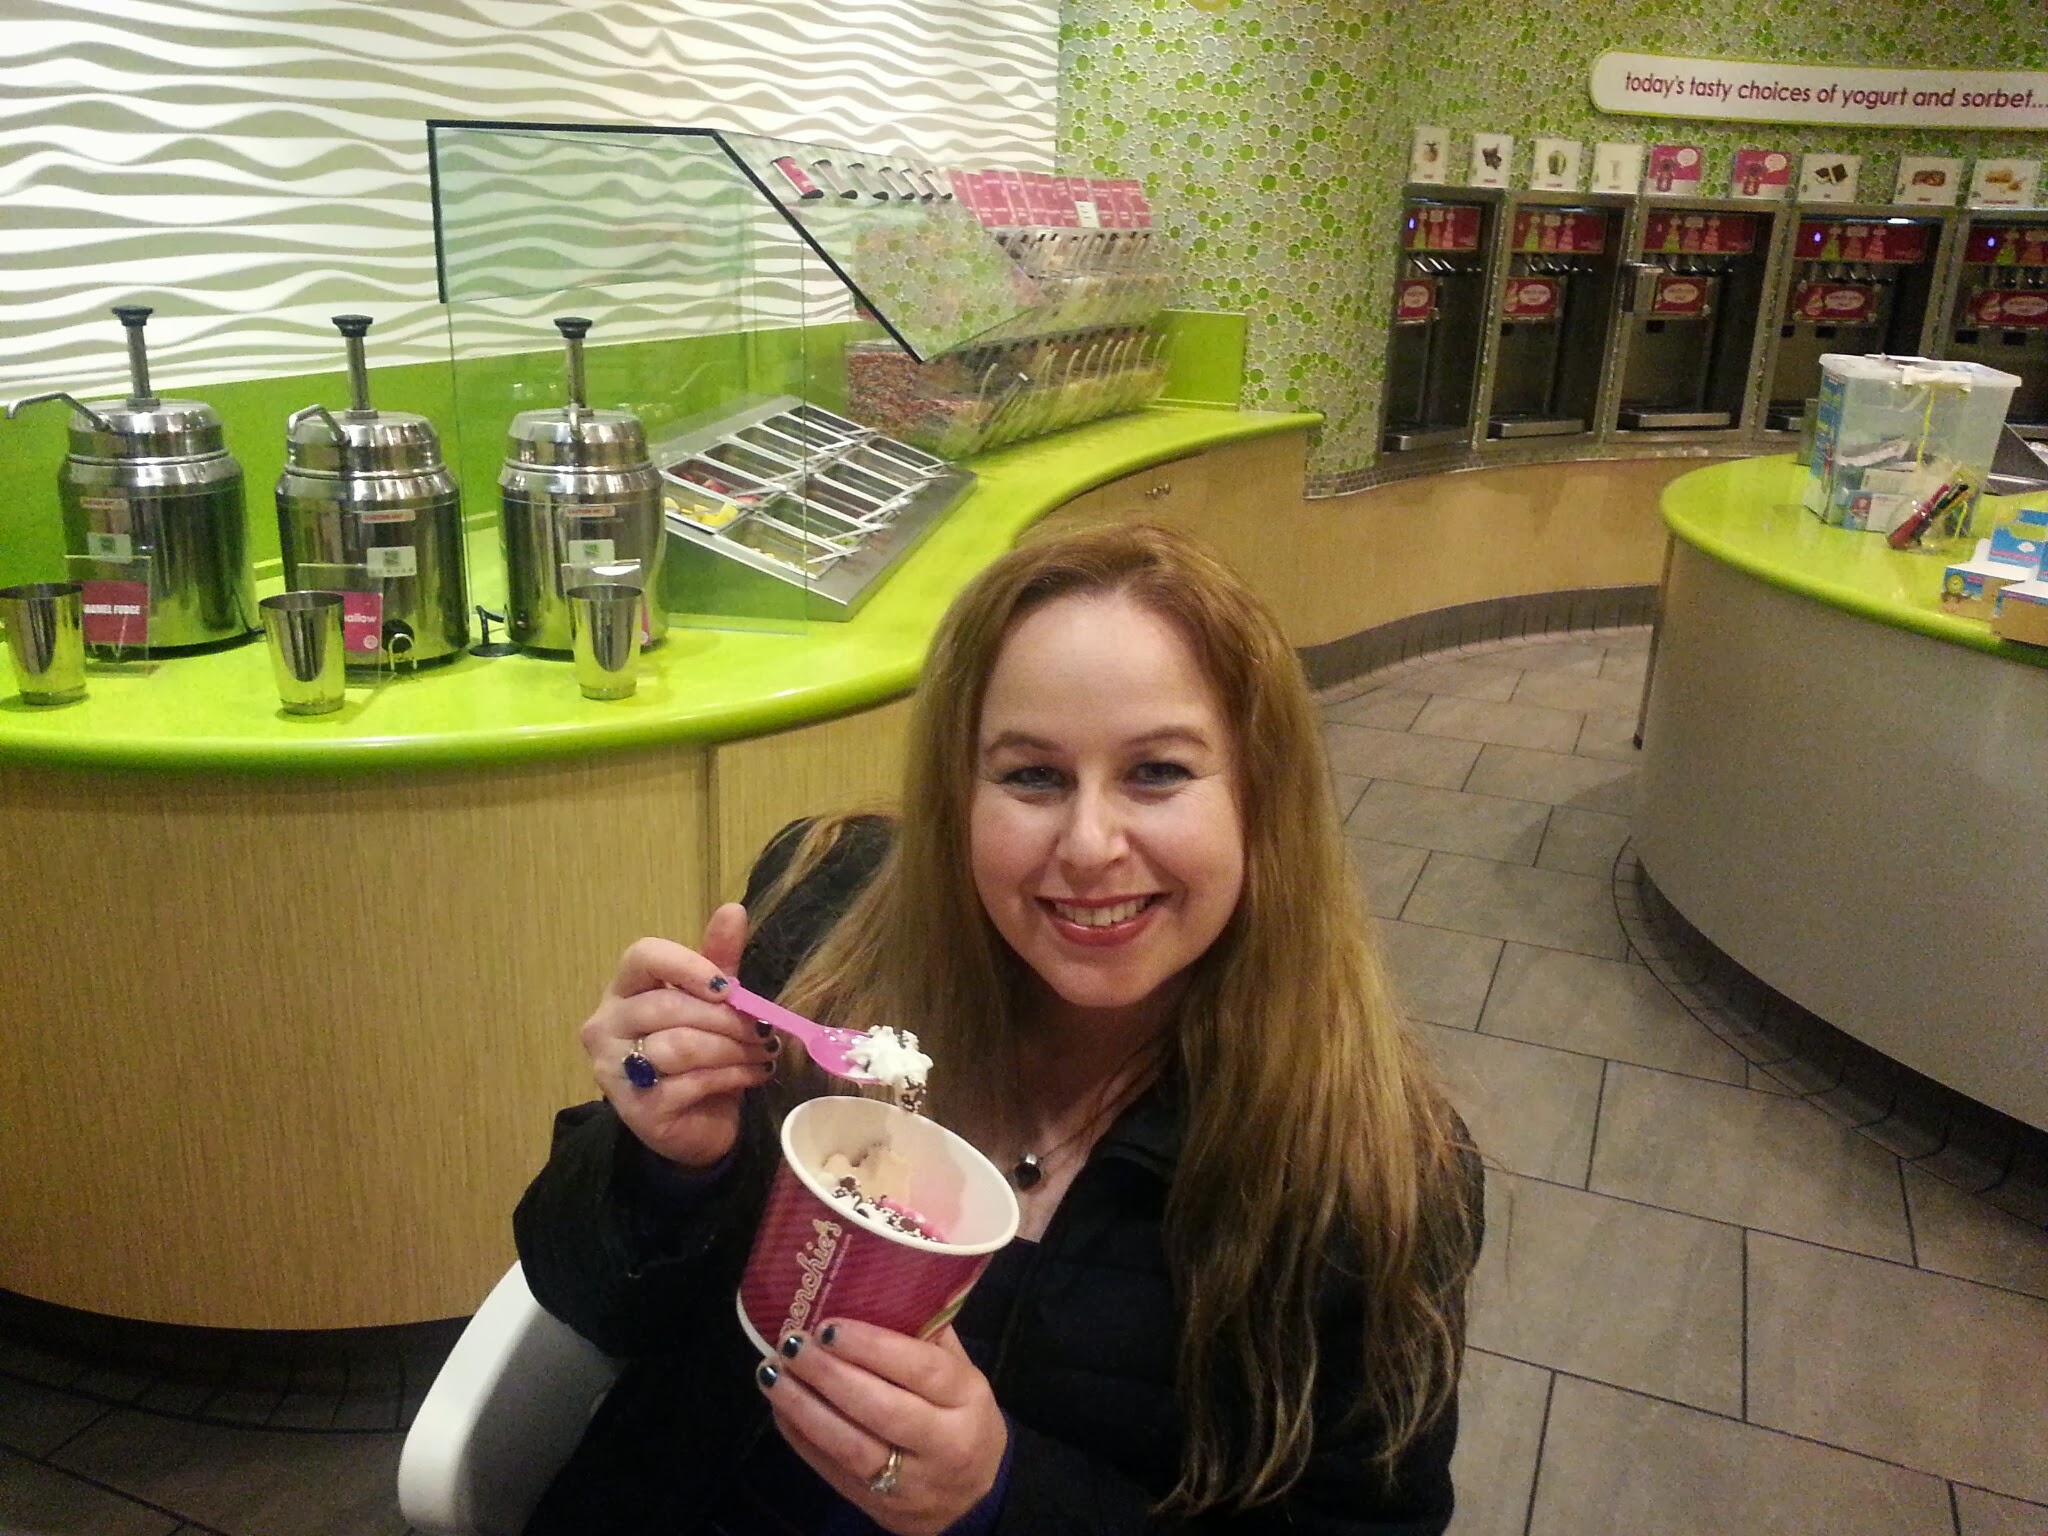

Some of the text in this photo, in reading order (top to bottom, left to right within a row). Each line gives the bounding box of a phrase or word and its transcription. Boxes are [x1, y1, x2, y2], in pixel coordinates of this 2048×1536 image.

[1625, 71, 1685, 99] today's
[1689, 76, 1733, 103] tasty
[1737, 80, 1811, 102] choices
[1816, 83, 1838, 104] of
[1841, 86, 1908, 110] yogurt
[1912, 87, 1956, 108] and
[113, 604, 141, 615] FUDGE
